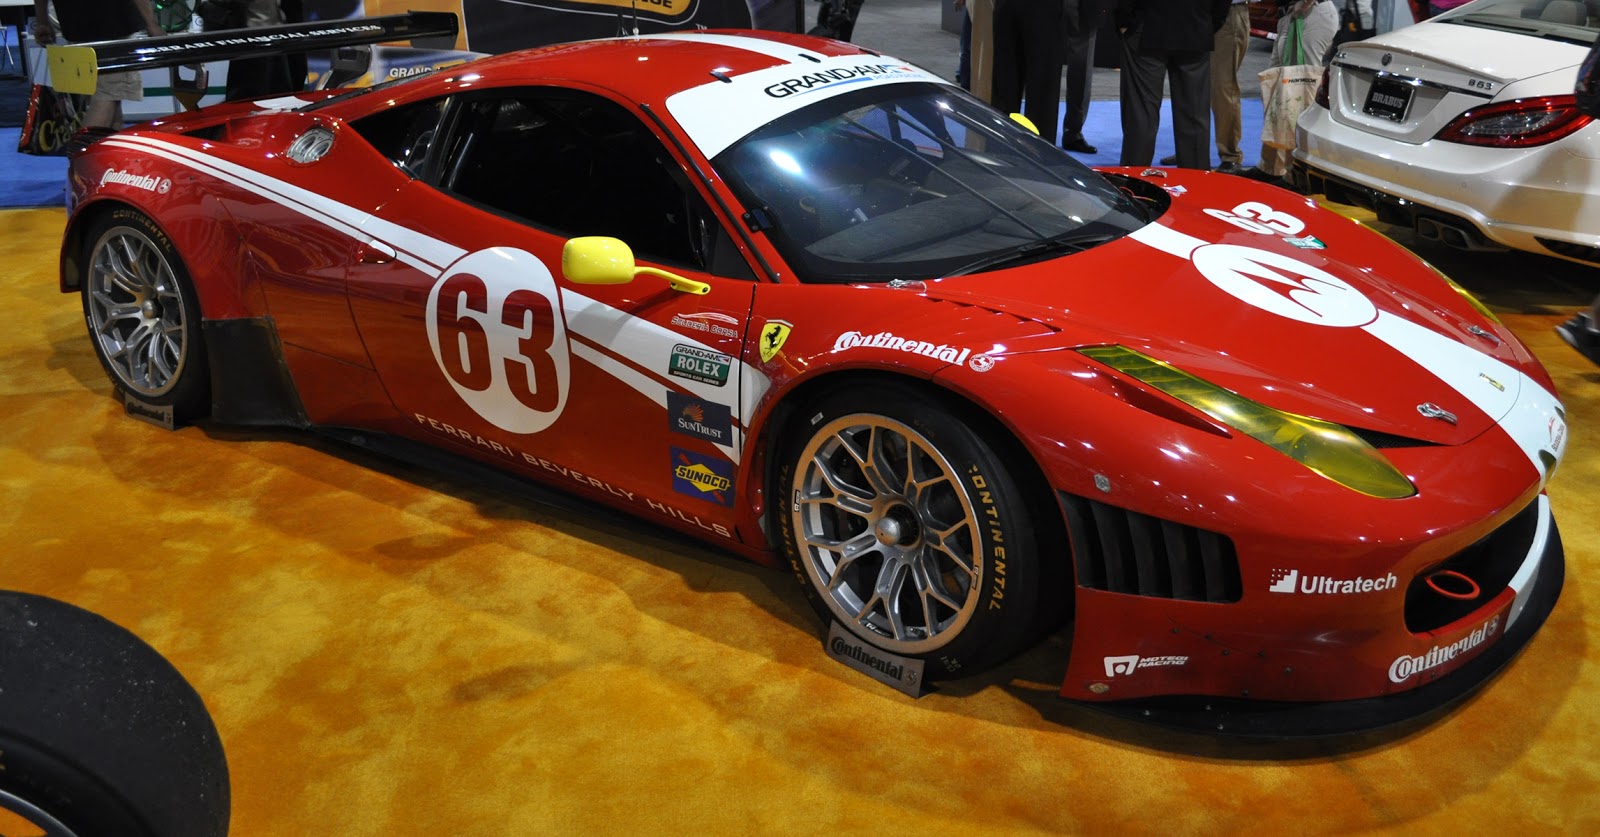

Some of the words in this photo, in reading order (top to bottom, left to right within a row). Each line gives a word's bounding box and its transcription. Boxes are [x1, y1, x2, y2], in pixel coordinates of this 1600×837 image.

[216, 32, 308, 46] FINANCIAL
[309, 24, 381, 37] SERVICES
[1371, 92, 1404, 109] BRABUS
[100, 168, 161, 192] Continental
[112, 209, 171, 252] CONTINENTAL
[437, 273, 560, 413] 63
[834, 331, 971, 367] Continental
[677, 355, 721, 377] ROLEX
[414, 412, 514, 457] FERRARI
[521, 451, 634, 501] BEVERLY
[646, 498, 731, 539] HILLS
[678, 466, 729, 490] SUNOCO
[1301, 572, 1397, 594] Ultratech
[831, 636, 904, 681] Continental
[1137, 660, 1185, 669] RACING
[1388, 622, 1487, 683] Continental
